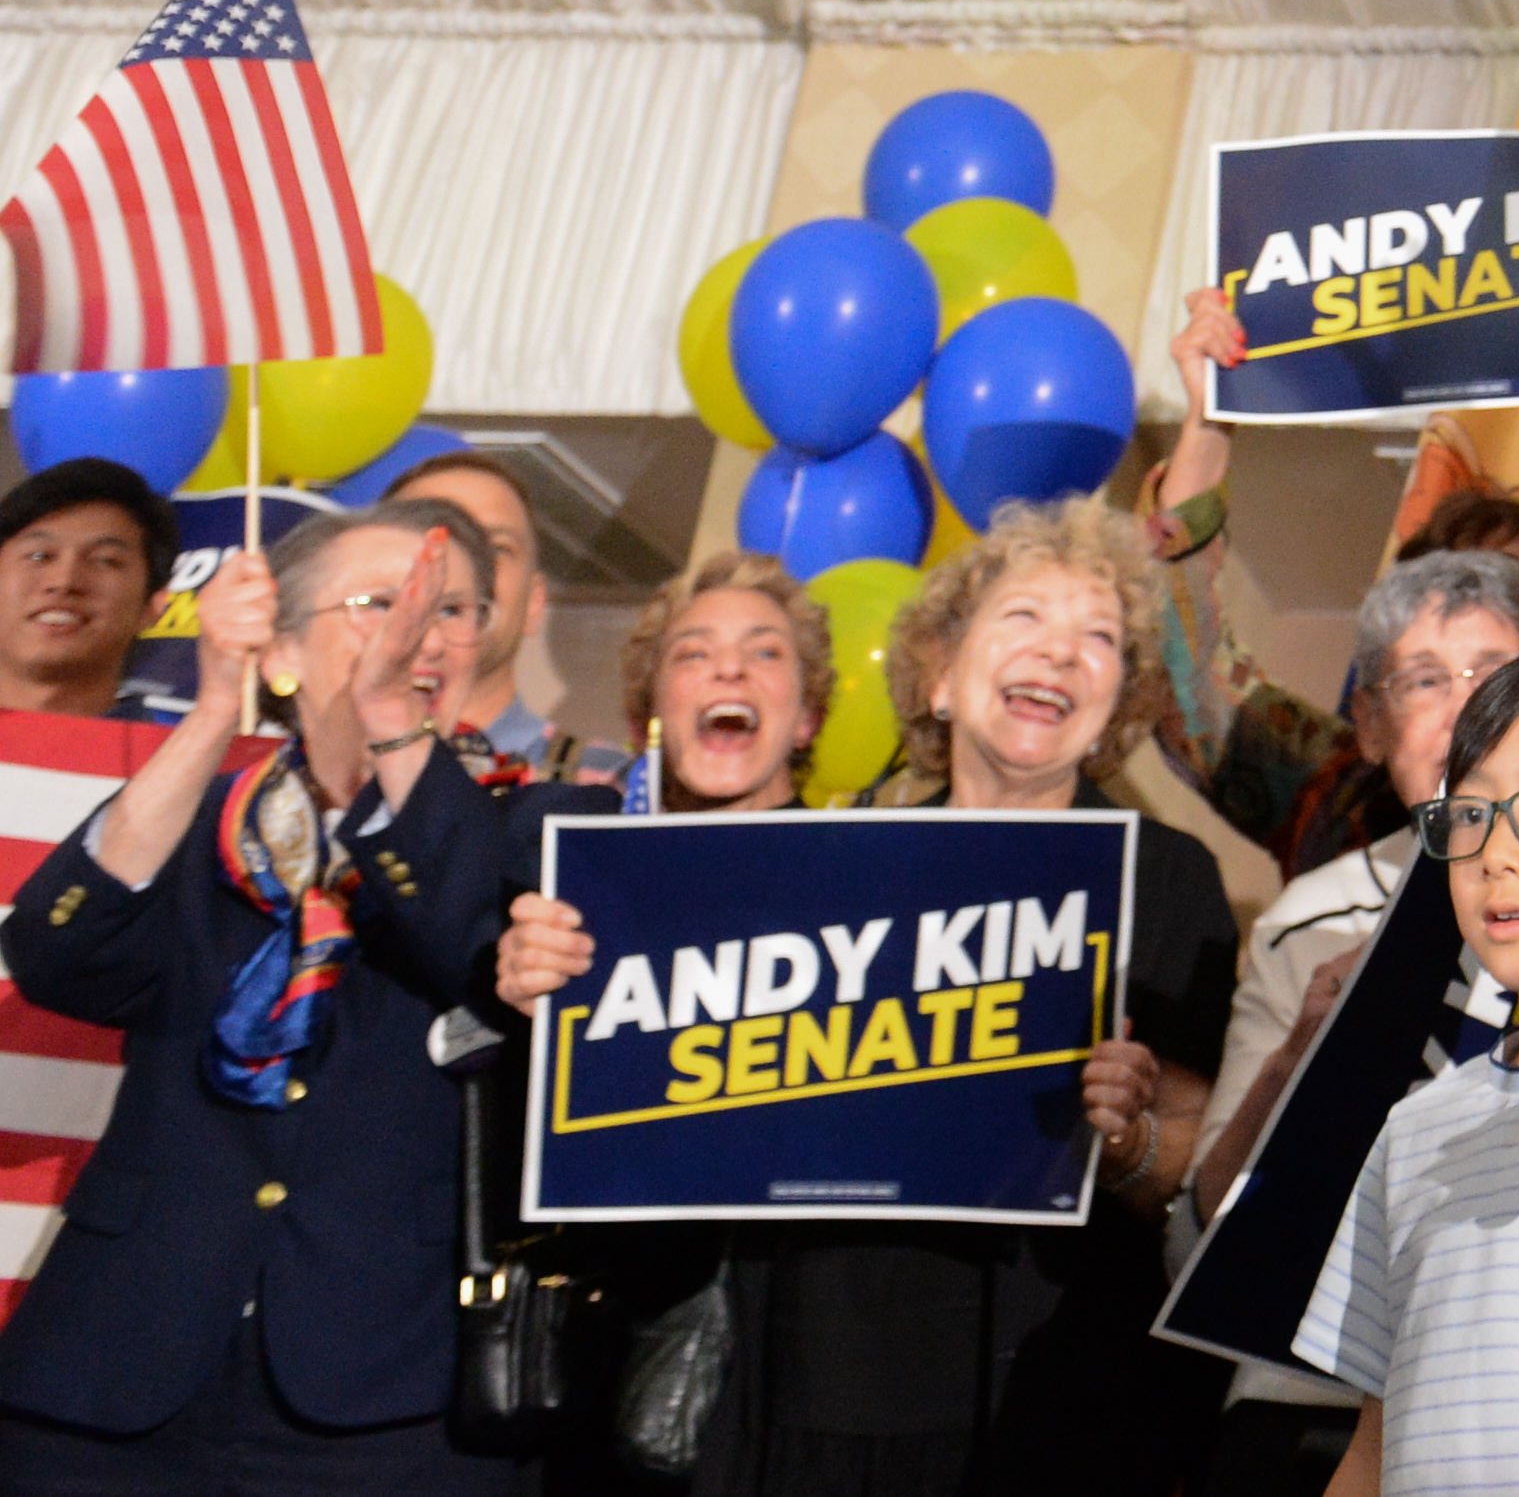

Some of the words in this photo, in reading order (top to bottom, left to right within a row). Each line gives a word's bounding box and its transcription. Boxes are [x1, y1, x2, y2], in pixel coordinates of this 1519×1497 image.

[1245, 197, 1482, 295] ANDY
[584, 917, 894, 1041] ANDY
[913, 890, 1089, 992] KIM
[665, 980, 1025, 1104] SENATE
